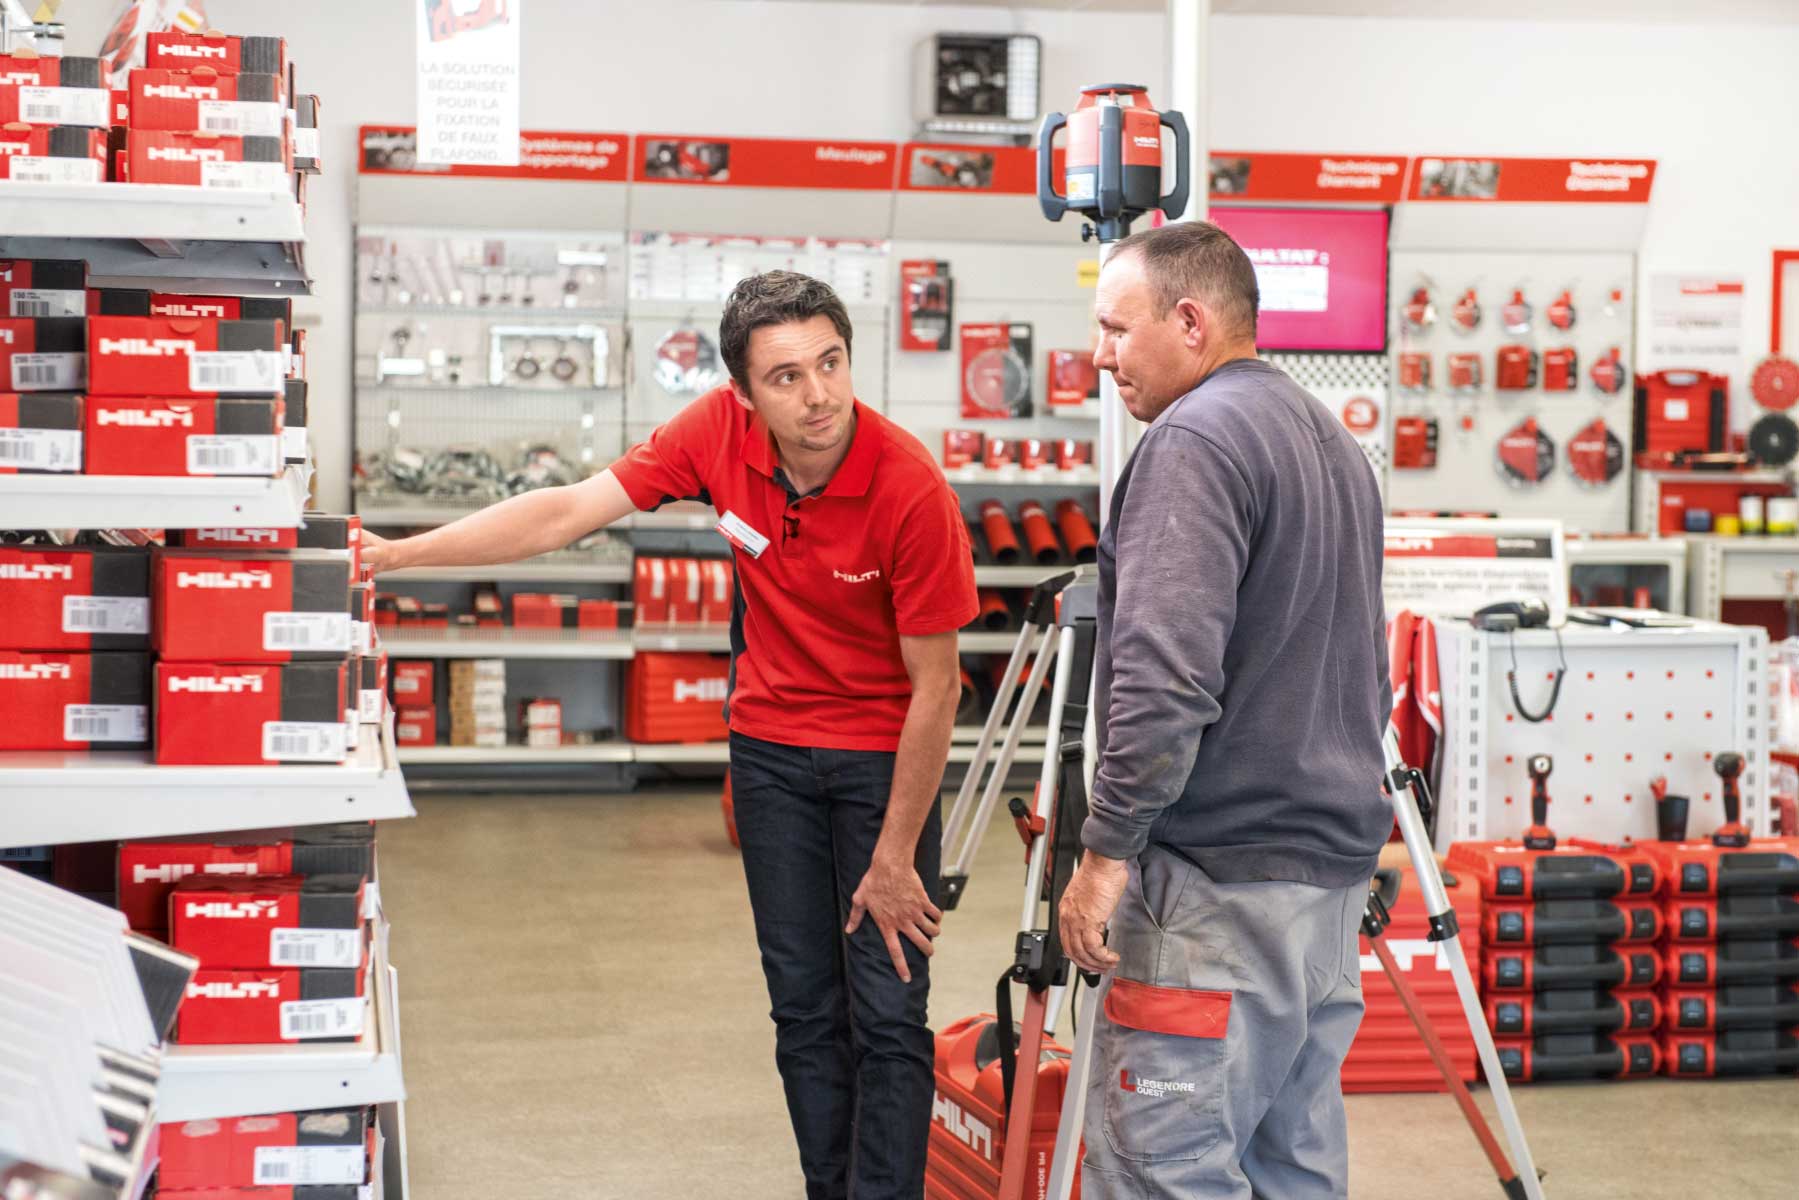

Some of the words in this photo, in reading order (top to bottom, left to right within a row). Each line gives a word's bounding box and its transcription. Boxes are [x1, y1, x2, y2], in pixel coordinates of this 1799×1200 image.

[158, 43, 226, 58] HILTI
[144, 84, 218, 99] HILTI
[147, 146, 224, 161] HILTI
[151, 304, 224, 317] HILTI
[99, 338, 195, 355] HILTI
[97, 408, 193, 426] HILTI
[197, 528, 279, 543] HILTI
[177, 572, 272, 589] HILTI
[833, 570, 879, 583] HILTI
[0, 663, 70, 679] ILTI
[168, 676, 262, 692] HILTI
[186, 901, 279, 918] HILTI
[185, 981, 279, 998] HILTI
[1137, 1078, 1195, 1092] LEGENDRE
[1137, 1087, 1165, 1097] OUEST
[932, 1089, 992, 1161] HILTI
